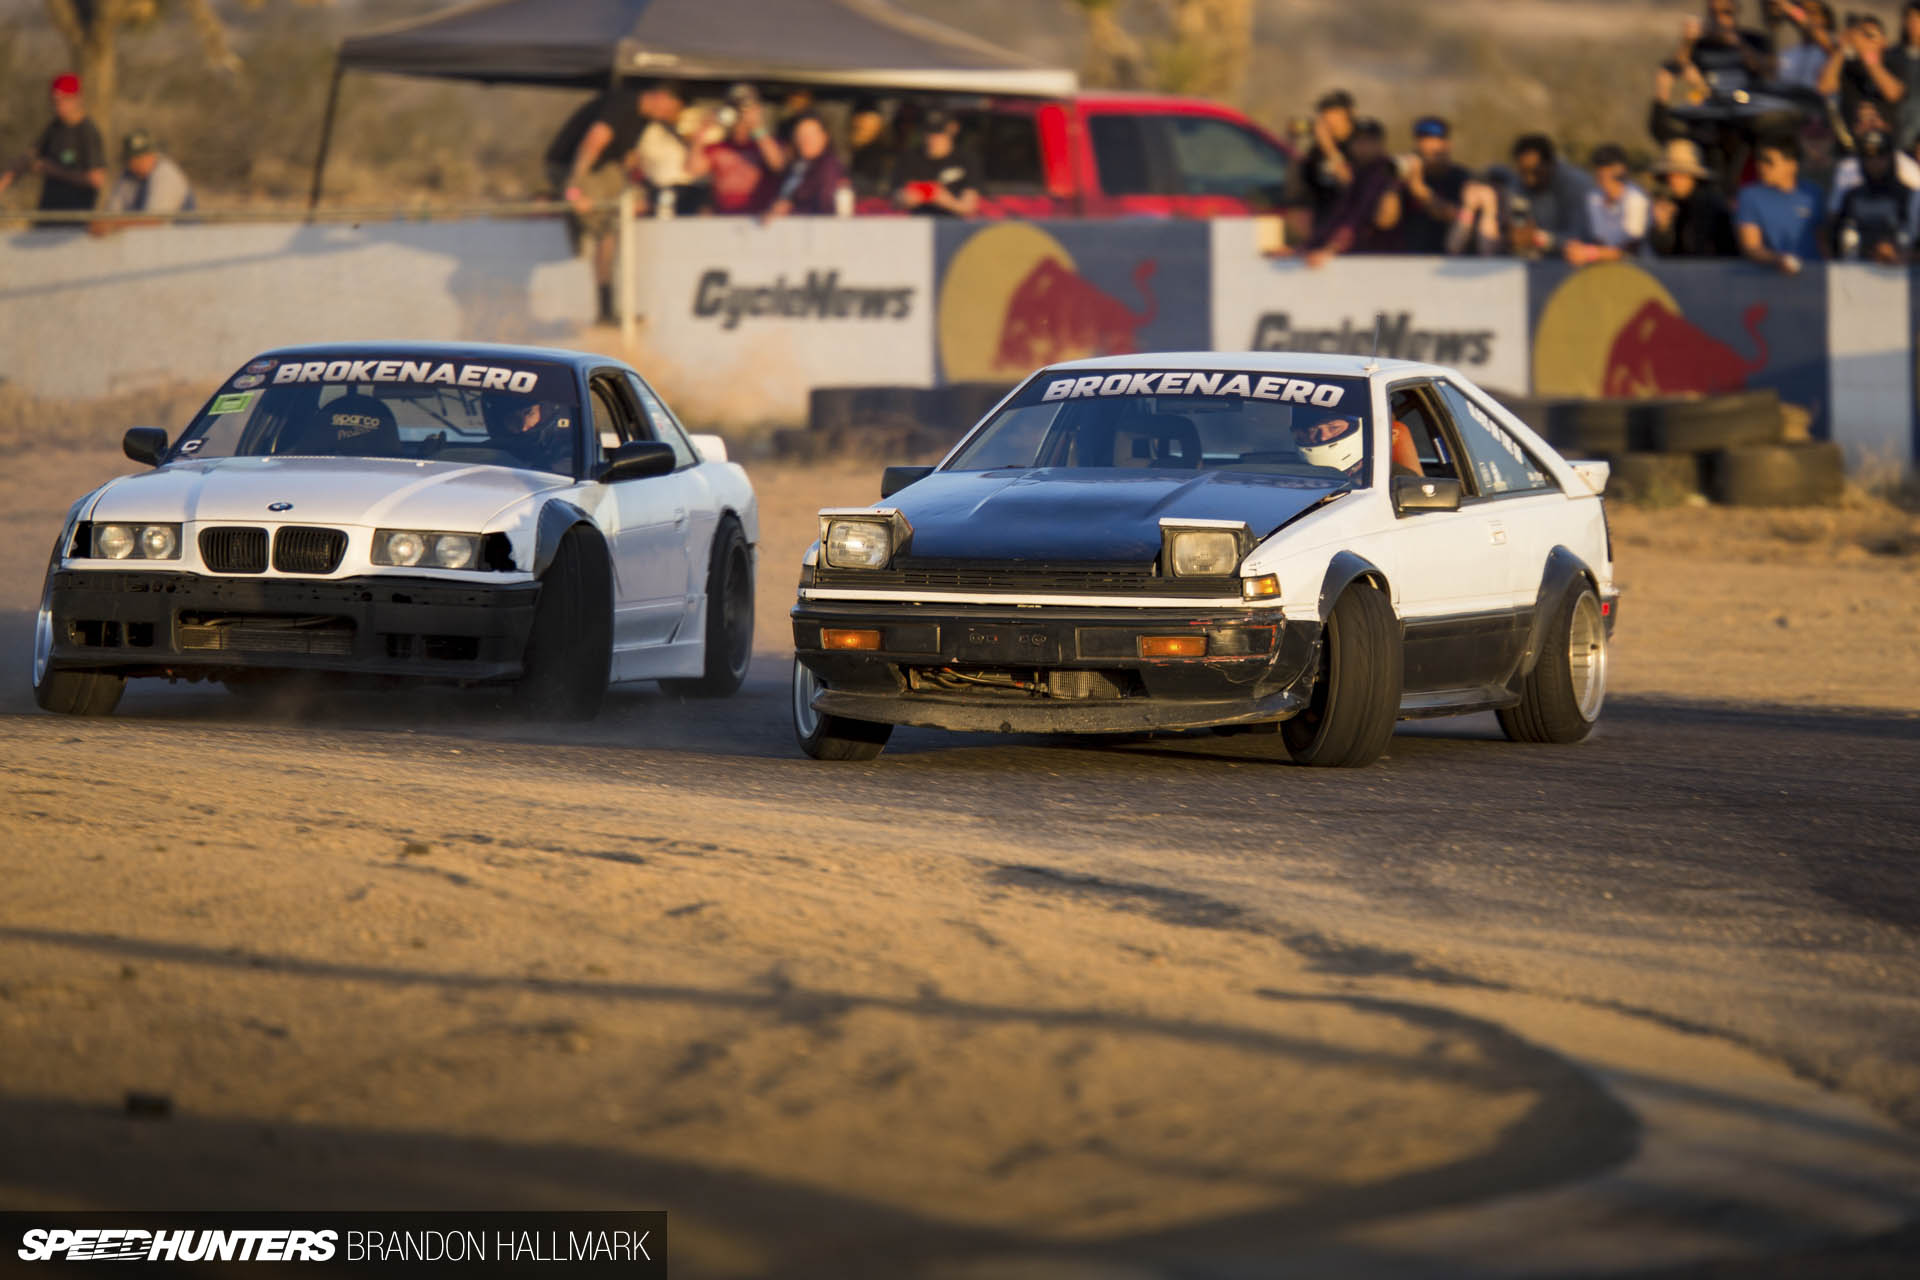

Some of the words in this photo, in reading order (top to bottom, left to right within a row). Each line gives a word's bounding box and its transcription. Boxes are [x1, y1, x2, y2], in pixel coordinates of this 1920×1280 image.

[693, 269, 916, 331] CycleNews
[272, 360, 538, 393] BROKENAERO
[1042, 372, 1345, 408] BROKENAERO
[332, 414, 381, 428] sparco
